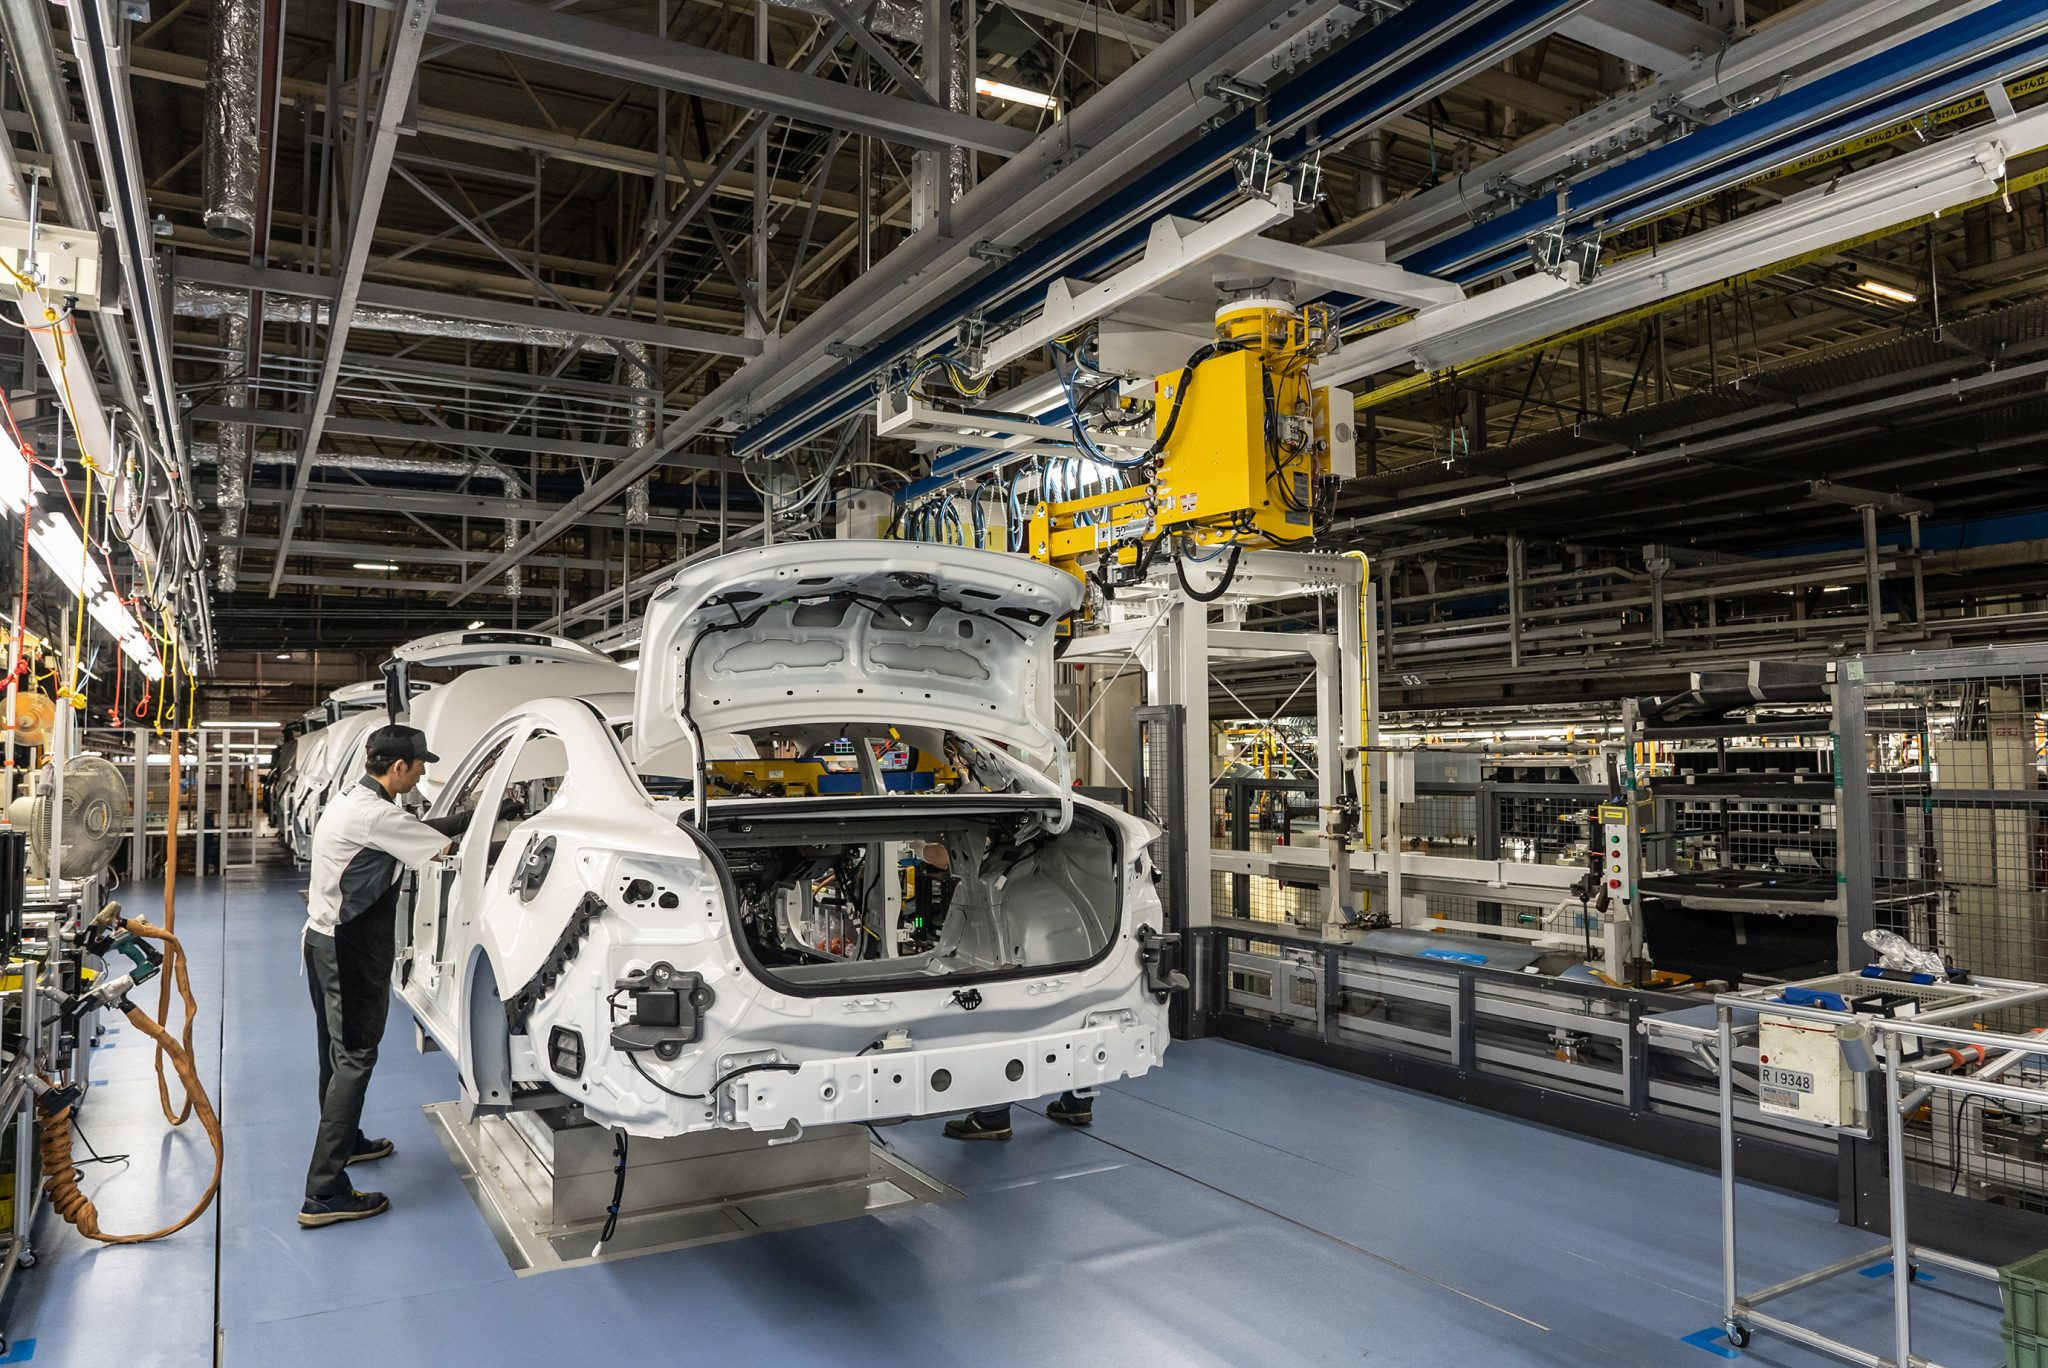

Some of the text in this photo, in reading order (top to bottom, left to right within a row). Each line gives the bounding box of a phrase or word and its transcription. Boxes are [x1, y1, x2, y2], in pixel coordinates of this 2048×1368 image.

[2012, 75, 2048, 95] きけん立
[1402, 675, 1421, 686] 53
[1763, 1069, 1810, 1089] R 19348
